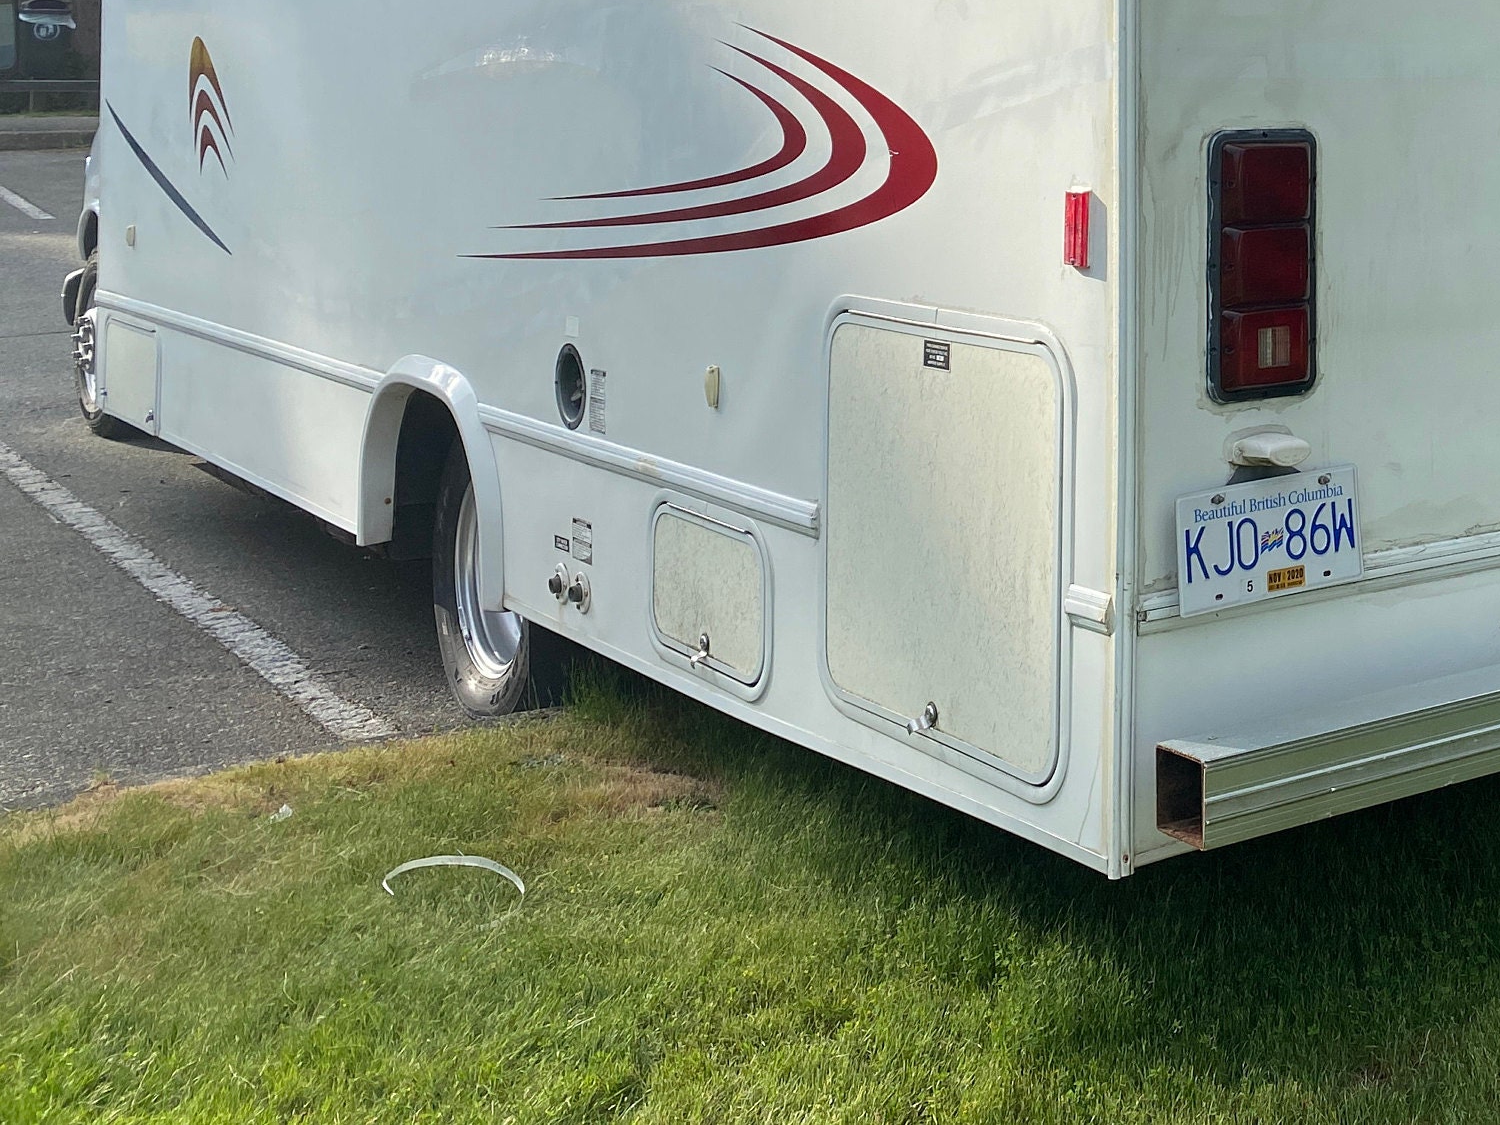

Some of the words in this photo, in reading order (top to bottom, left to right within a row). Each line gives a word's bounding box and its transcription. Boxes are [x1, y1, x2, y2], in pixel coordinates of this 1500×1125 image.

[1194, 501, 1246, 523] Beautiful
[1250, 495, 1286, 512] British
[1288, 484, 1343, 505] Columbia
[1247, 580, 1253, 592] 5
